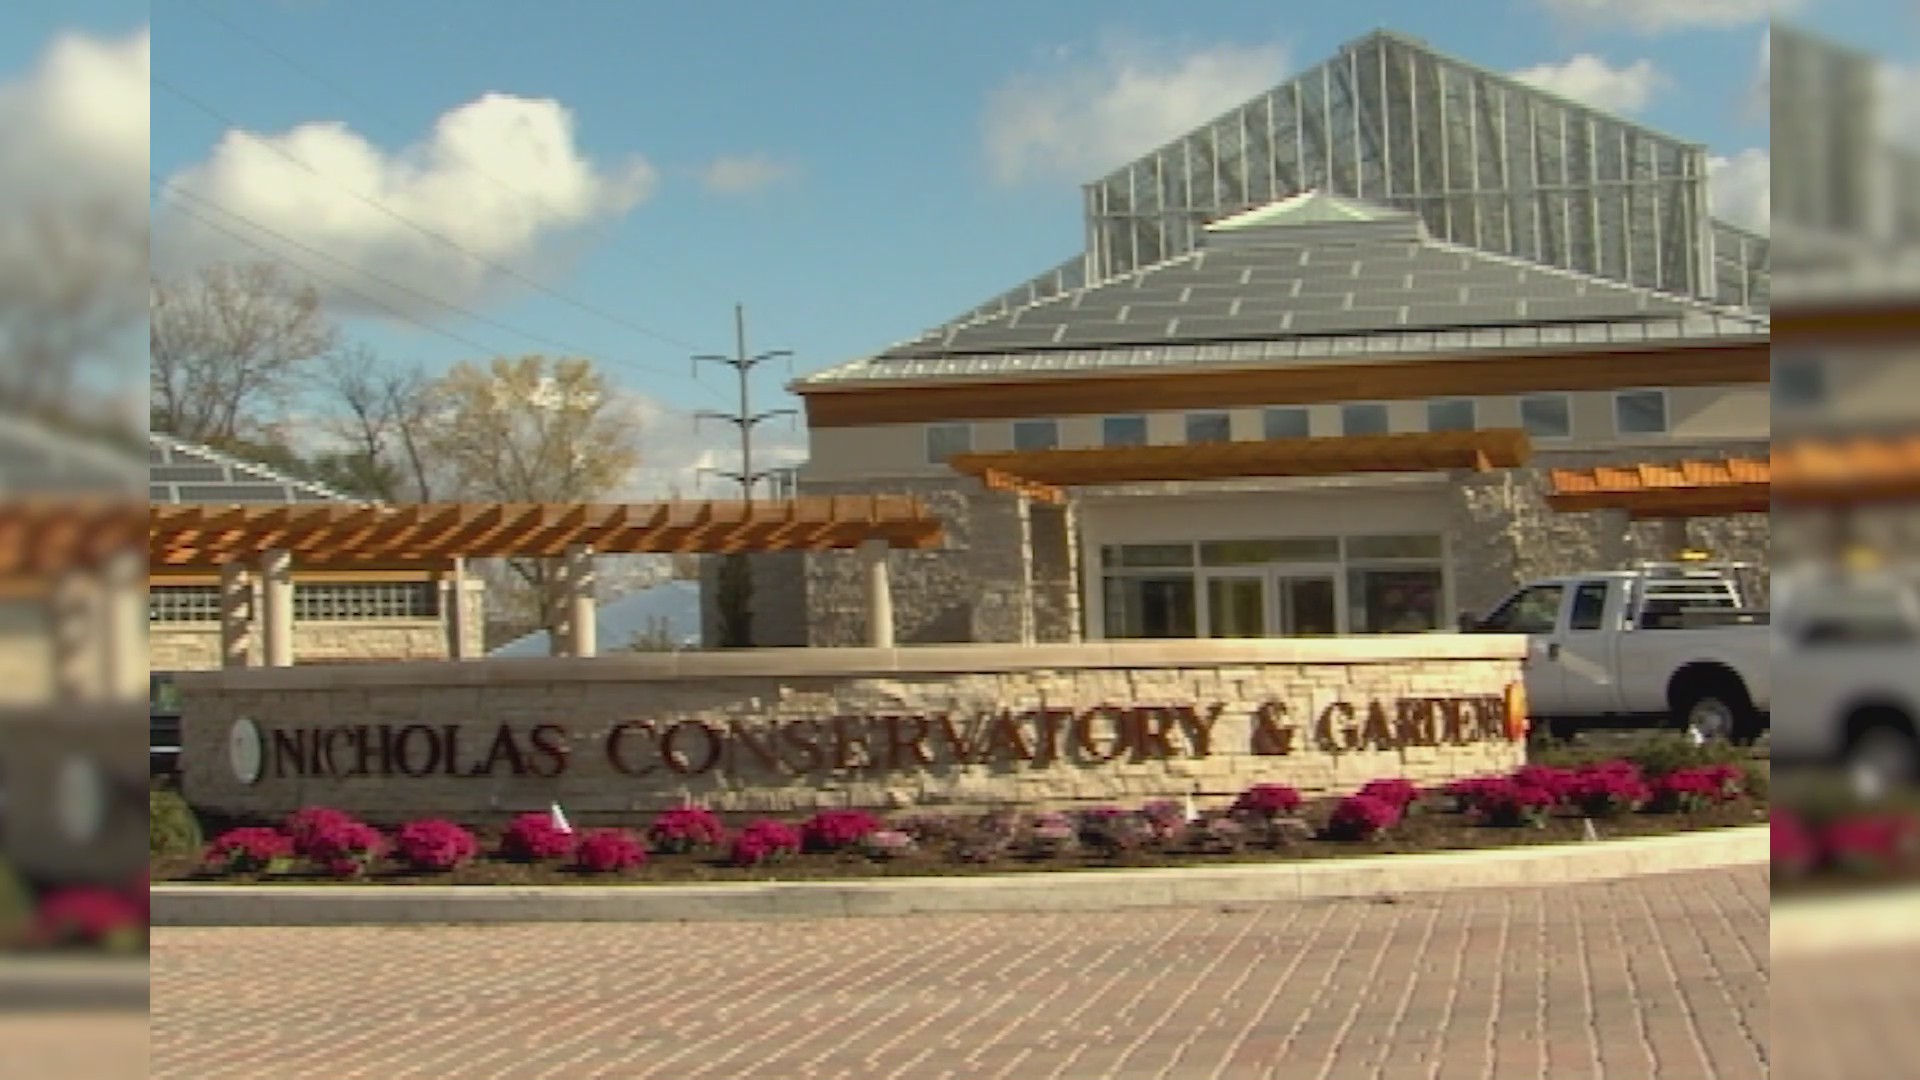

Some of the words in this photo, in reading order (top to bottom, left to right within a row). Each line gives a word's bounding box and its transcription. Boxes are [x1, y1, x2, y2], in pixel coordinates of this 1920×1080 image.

[273, 721, 568, 778] NICHOLAS
[606, 704, 1225, 778] CONSERVATORY
[1250, 700, 1295, 756] &
